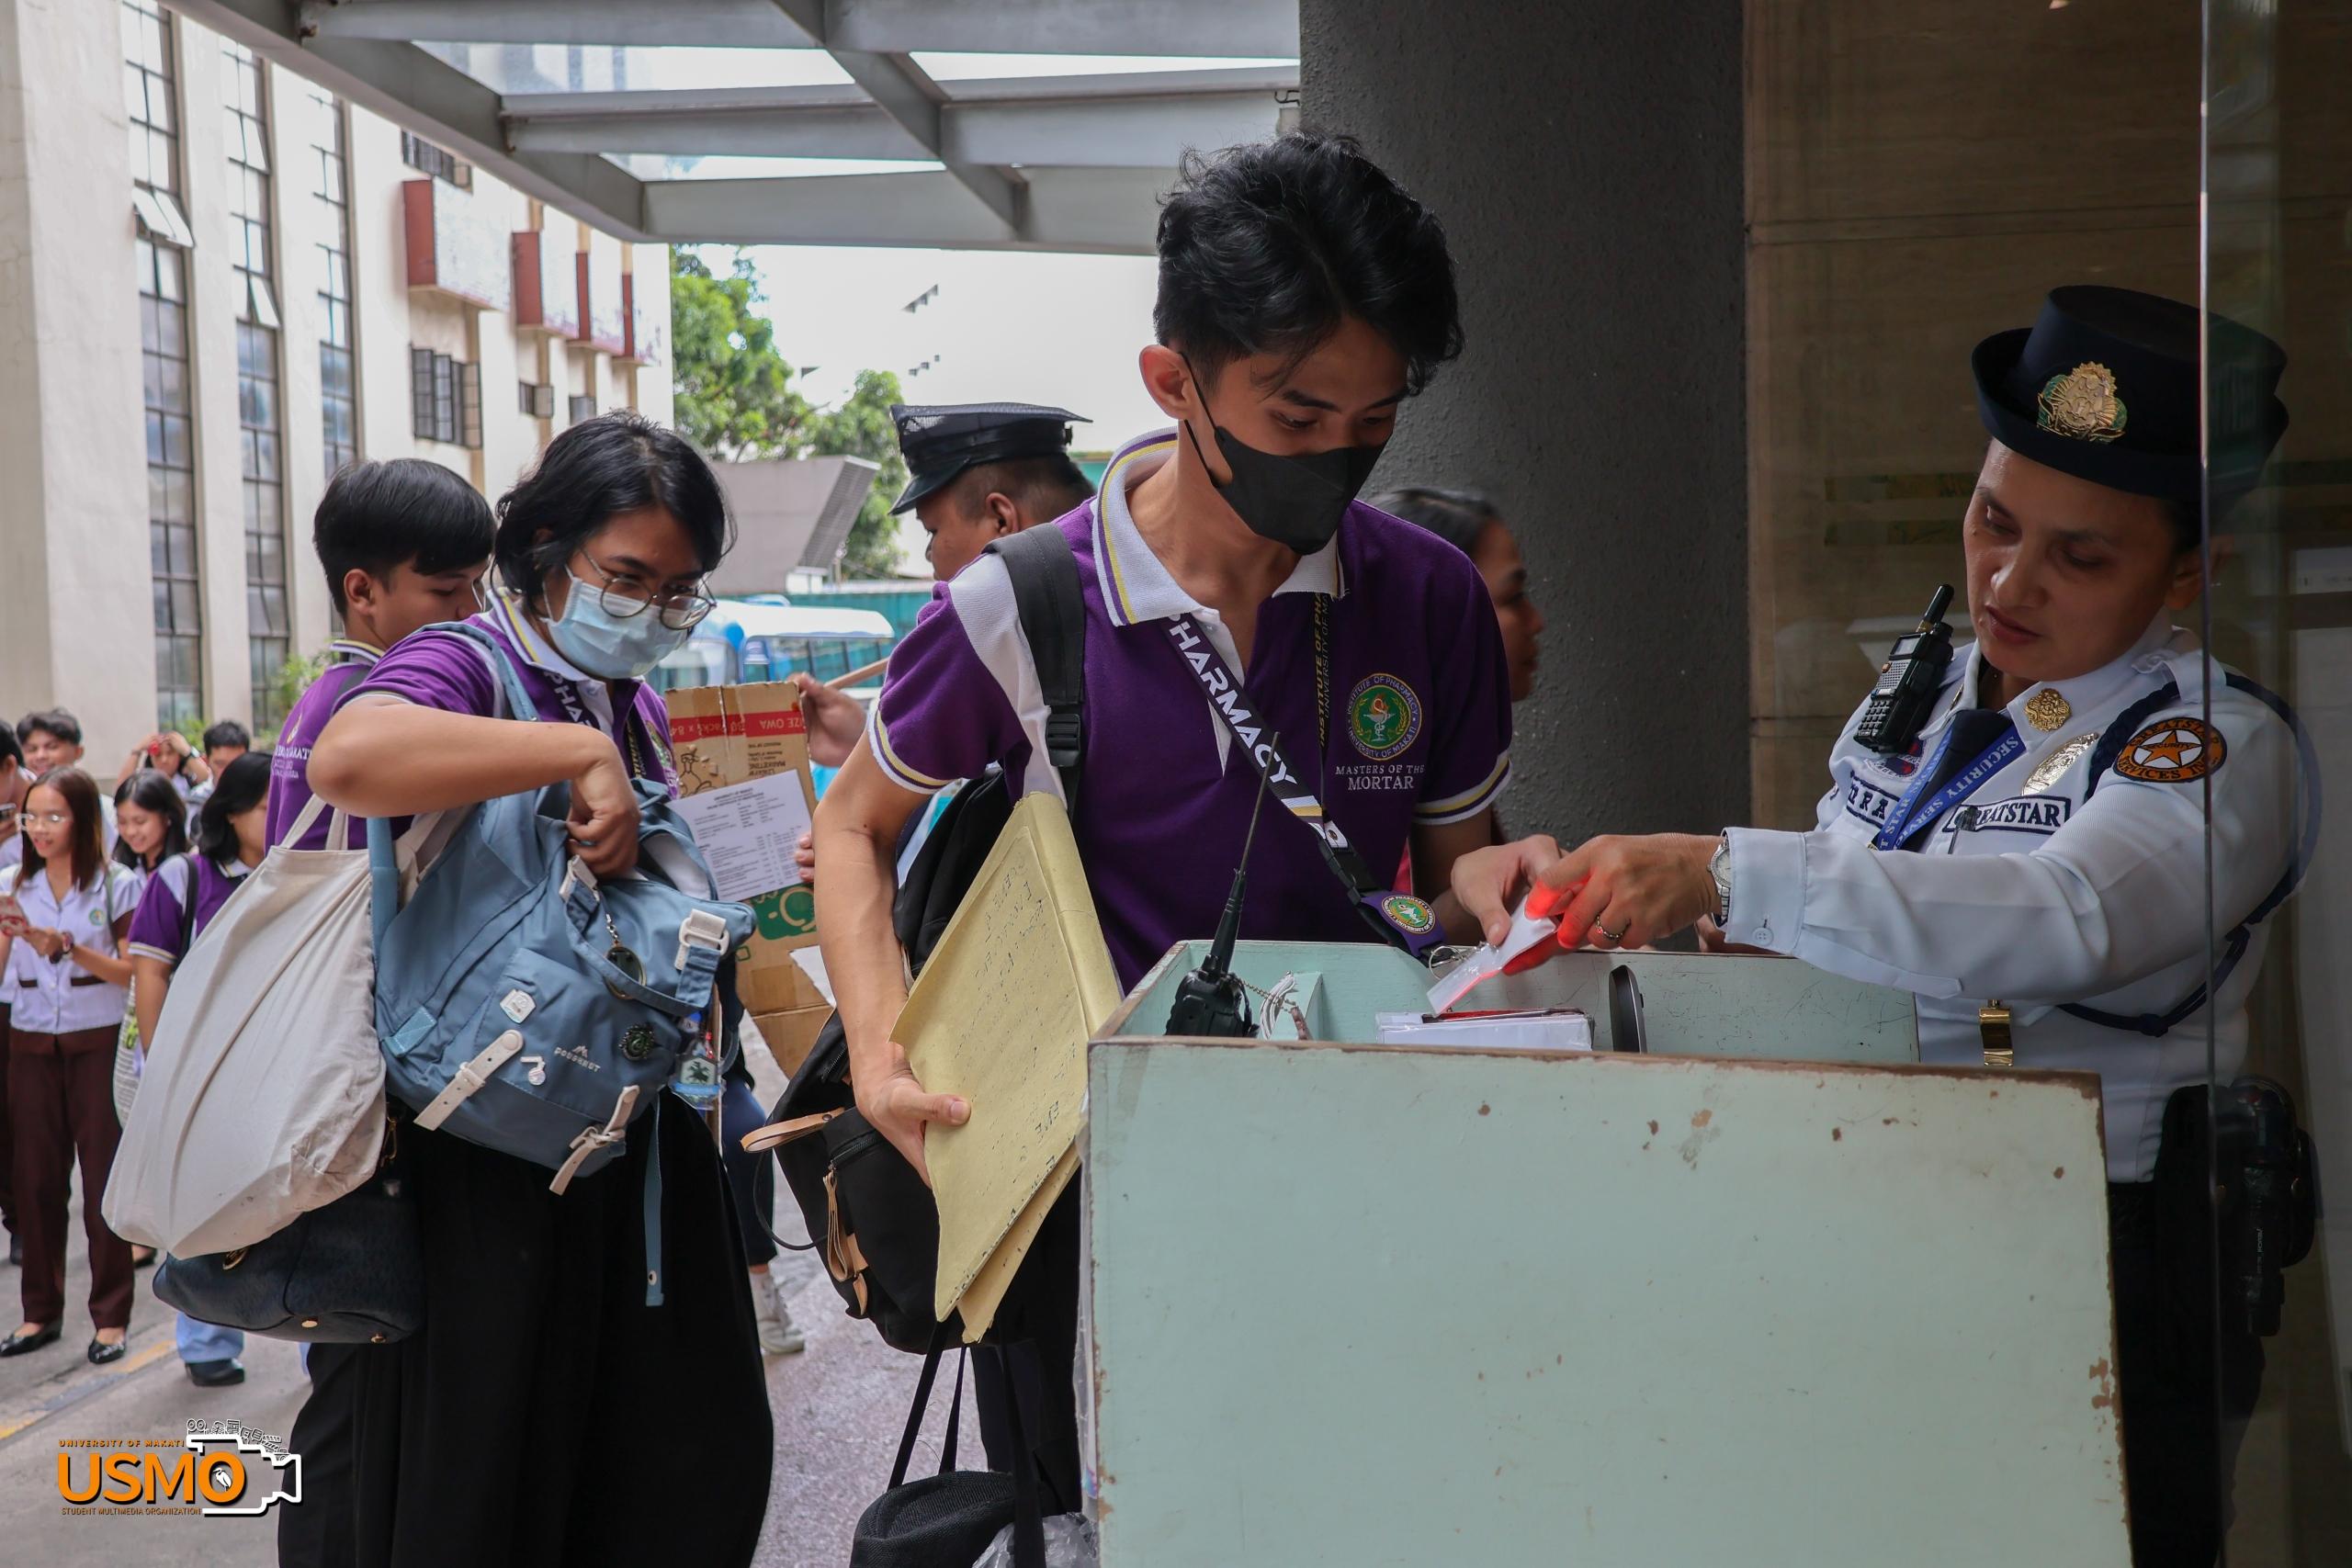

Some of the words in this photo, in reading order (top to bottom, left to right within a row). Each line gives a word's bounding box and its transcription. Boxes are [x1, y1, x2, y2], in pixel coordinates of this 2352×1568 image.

[543, 671, 594, 728] PHA
[1168, 614, 1297, 784] HARMACY
[1335, 765, 1385, 775] MASTERS
[1388, 764, 1403, 773] OF
[1407, 764, 1426, 773] THE
[1348, 775, 1415, 791] MORTAR
[1946, 736, 2019, 798] SECURITY
[1975, 801, 2061, 828] EATSTAR
